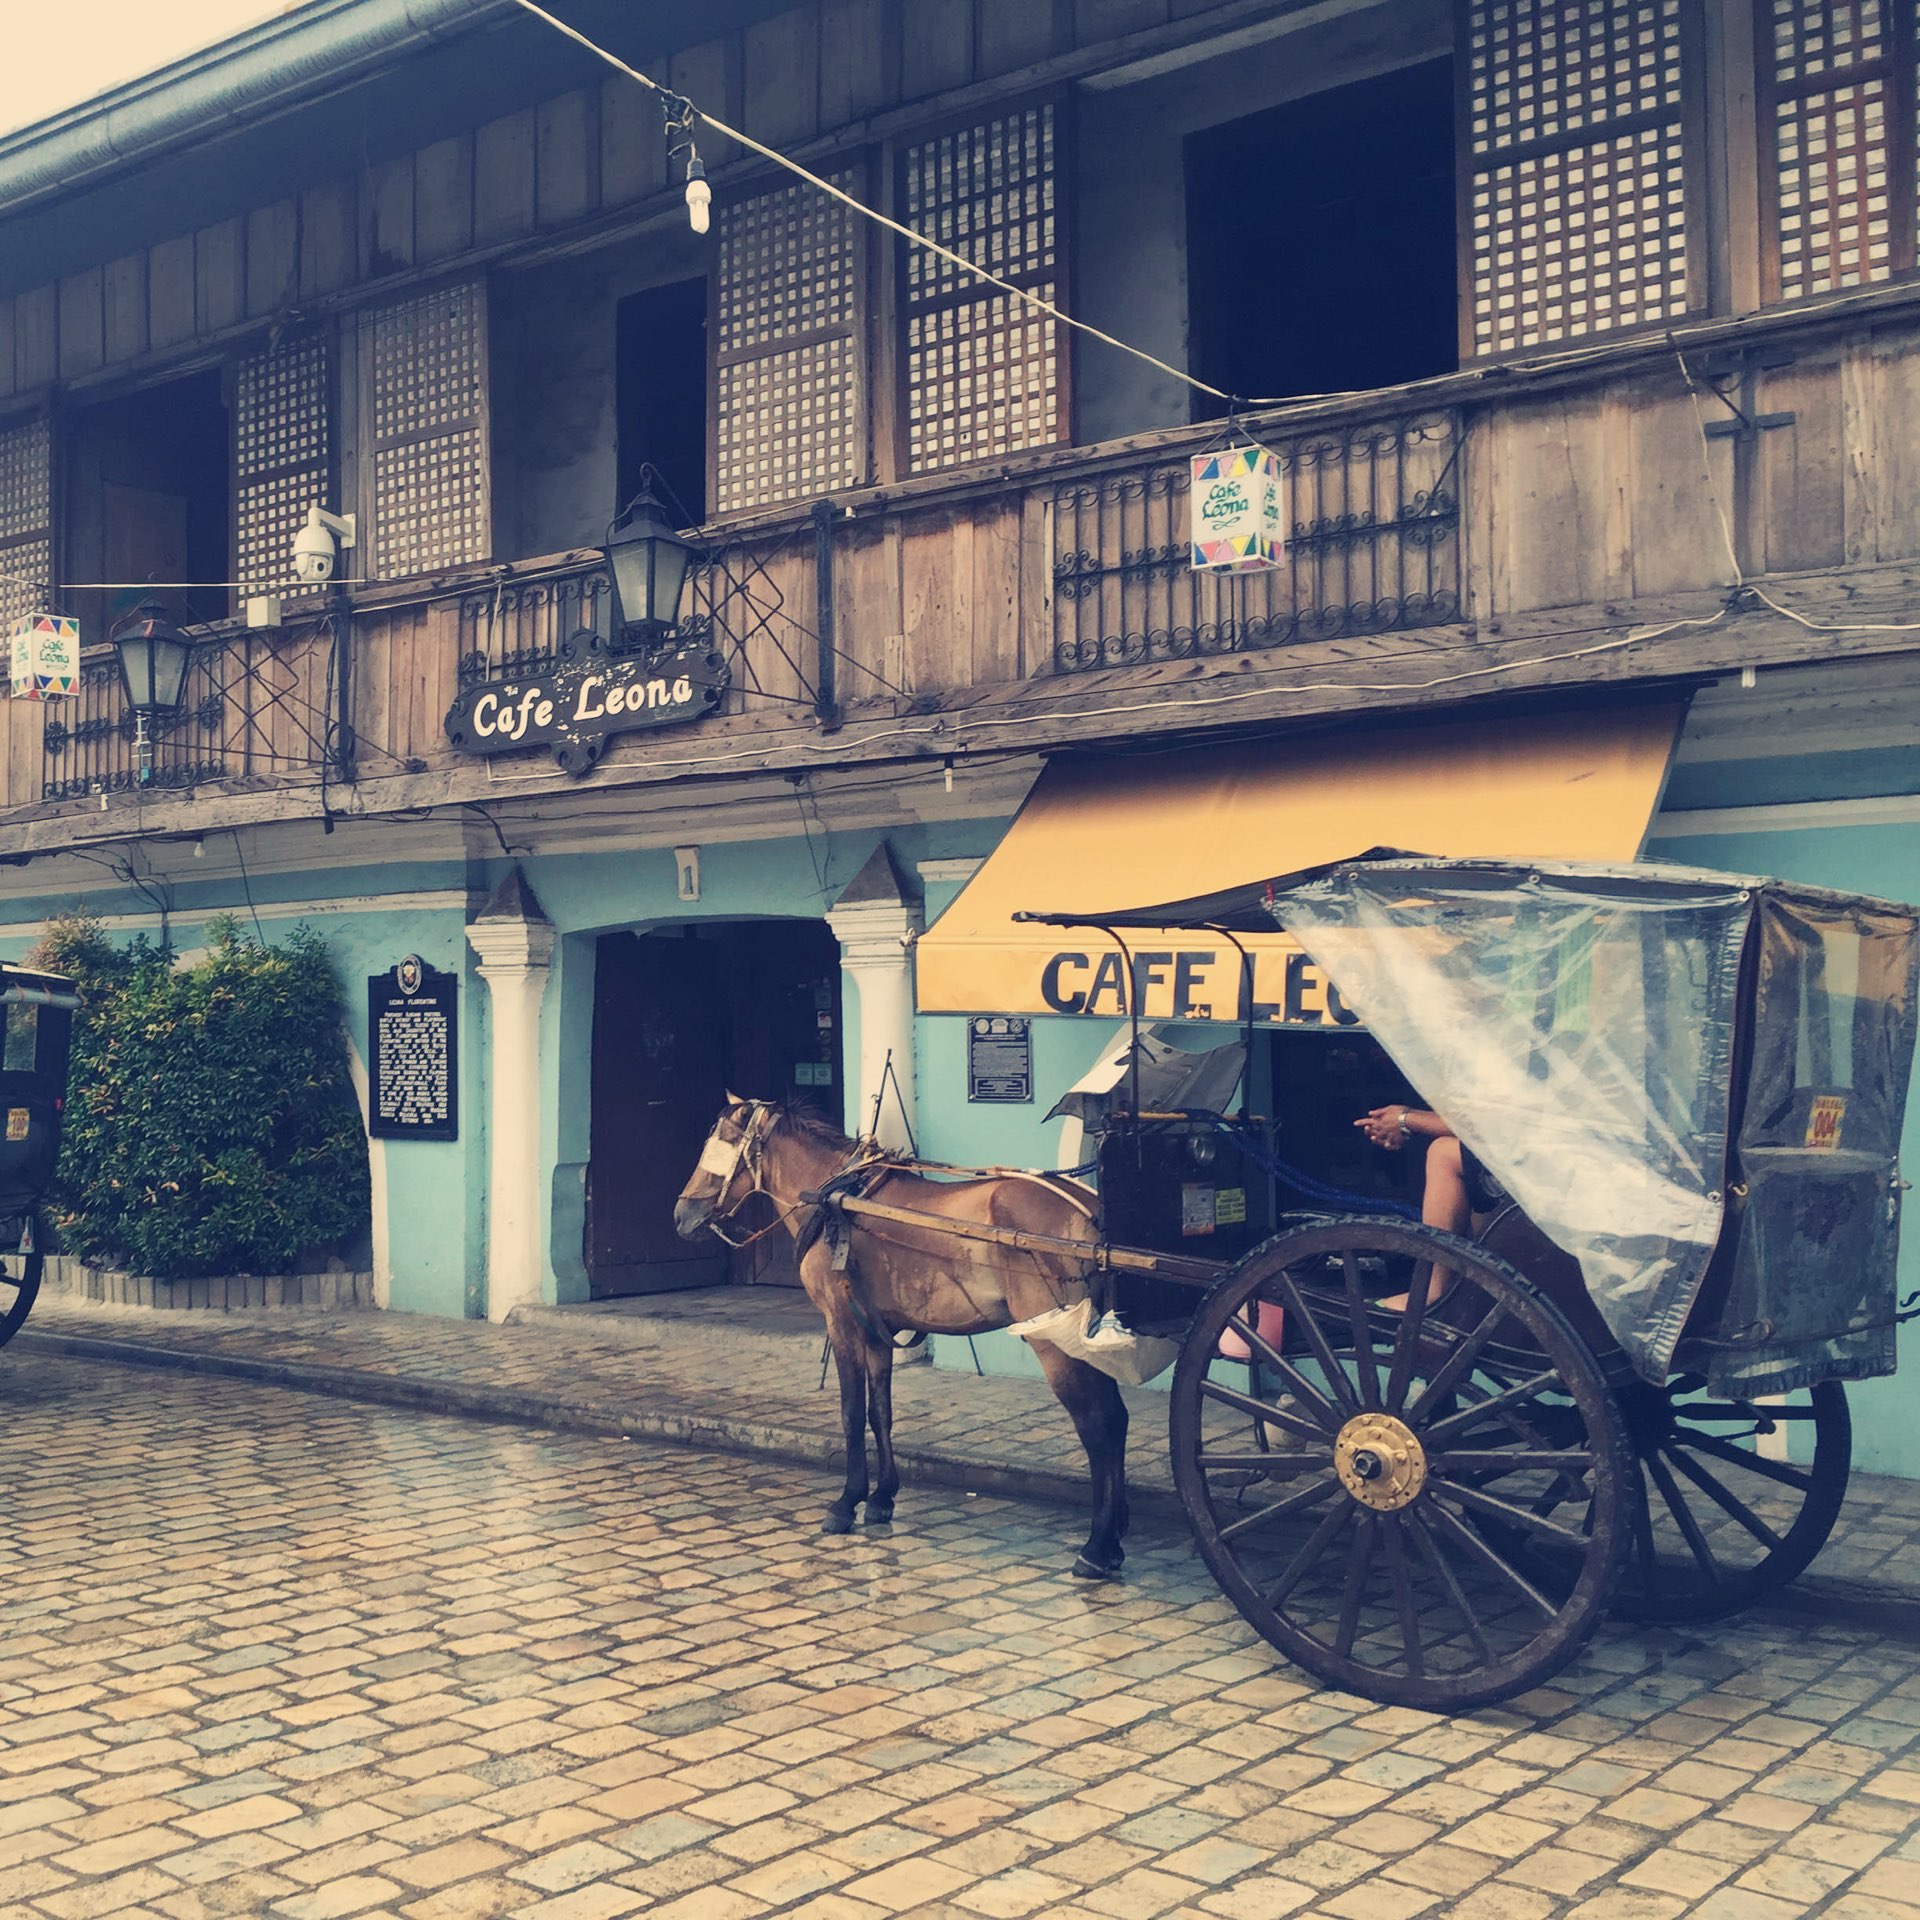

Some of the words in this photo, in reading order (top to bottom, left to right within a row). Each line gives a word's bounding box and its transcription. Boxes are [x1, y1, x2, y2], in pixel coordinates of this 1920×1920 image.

[1202, 498, 1249, 520] Leona
[1209, 481, 1241, 503] Cafe
[473, 687, 554, 741] Cafe
[572, 674, 693, 721] Leona
[1041, 951, 1216, 1019] CAFE
